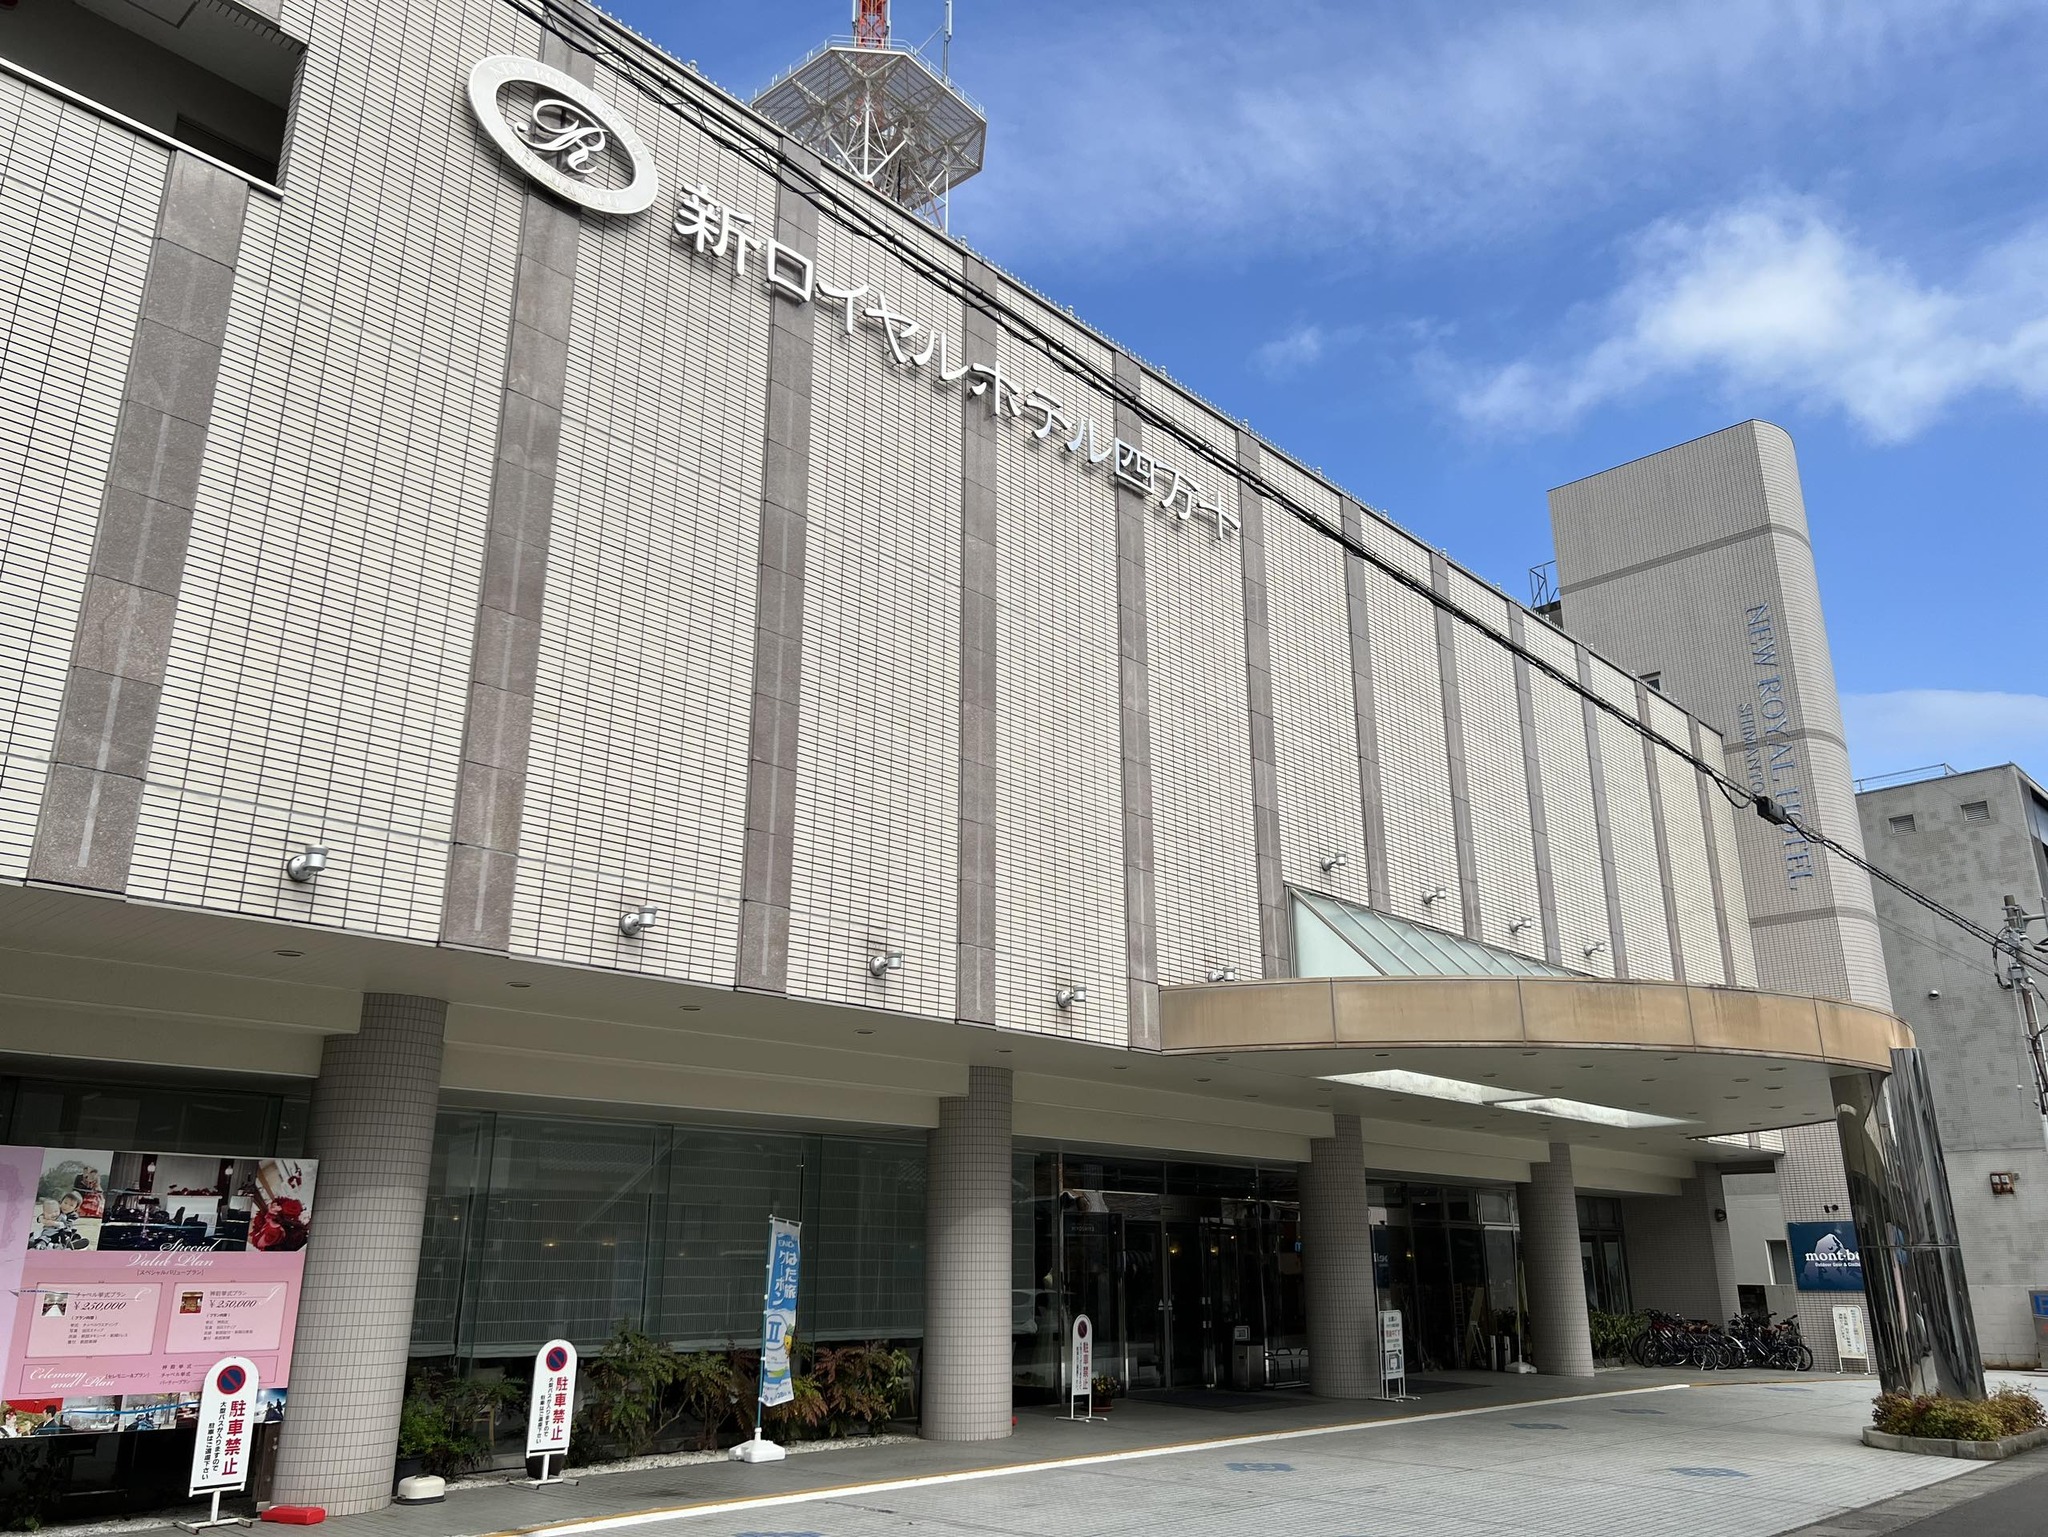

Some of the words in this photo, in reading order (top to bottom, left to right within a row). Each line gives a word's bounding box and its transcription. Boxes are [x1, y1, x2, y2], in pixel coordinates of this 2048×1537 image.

[674, 183, 1242, 541] 新ロイヤルホテル四万十
[1745, 602, 1779, 668] NEW
[1738, 702, 1766, 795] SHIMANTO
[1757, 675, 1797, 782] ROYAL
[174, 1251, 215, 1267] Plan
[785, 1251, 798, 1299] はた旅
[82, 1375, 116, 1388] Plan
[550, 1376, 569, 1441] 駐車禁止
[211, 1401, 227, 1472] 大型バスが入りますので
[221, 1399, 247, 1476] 駐車禁止
